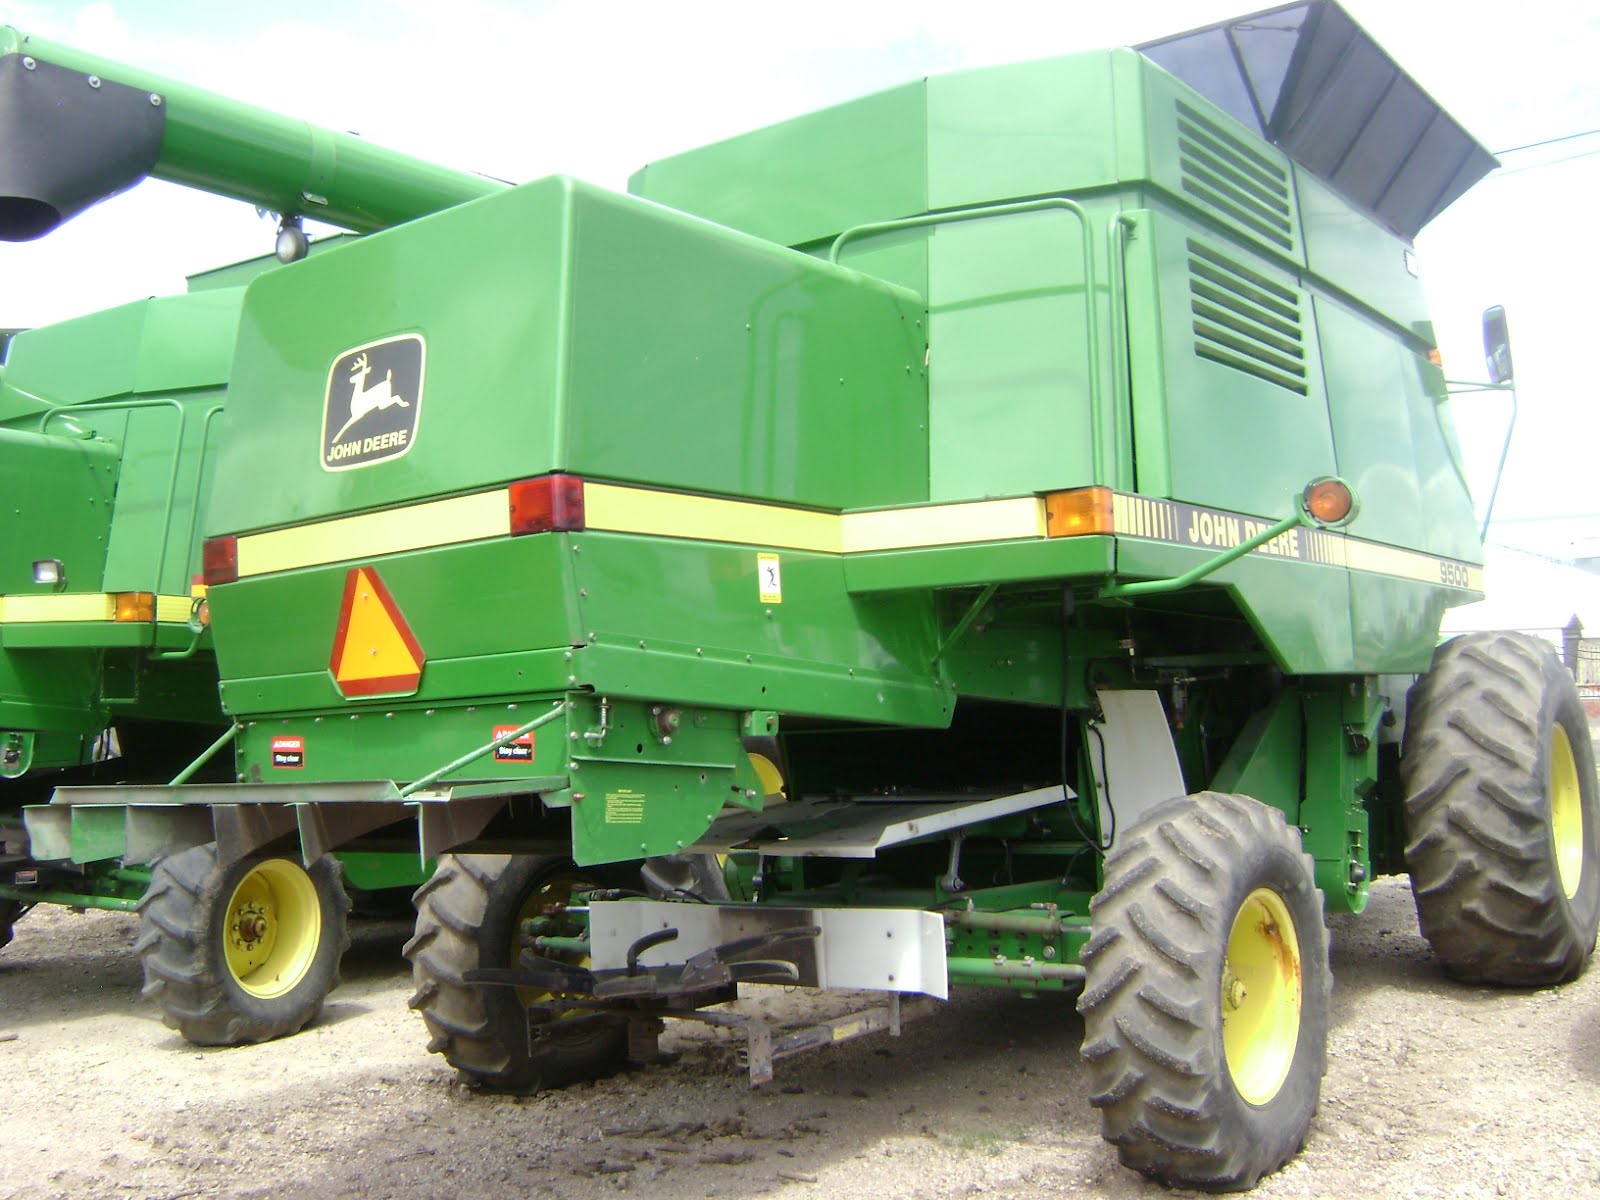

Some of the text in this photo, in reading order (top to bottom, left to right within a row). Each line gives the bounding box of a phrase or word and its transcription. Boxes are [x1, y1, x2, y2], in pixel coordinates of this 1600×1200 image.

[327, 429, 408, 461] JOHN DEERE
[1188, 511, 1240, 548] JOHN
[1440, 561, 1469, 587] 9500
